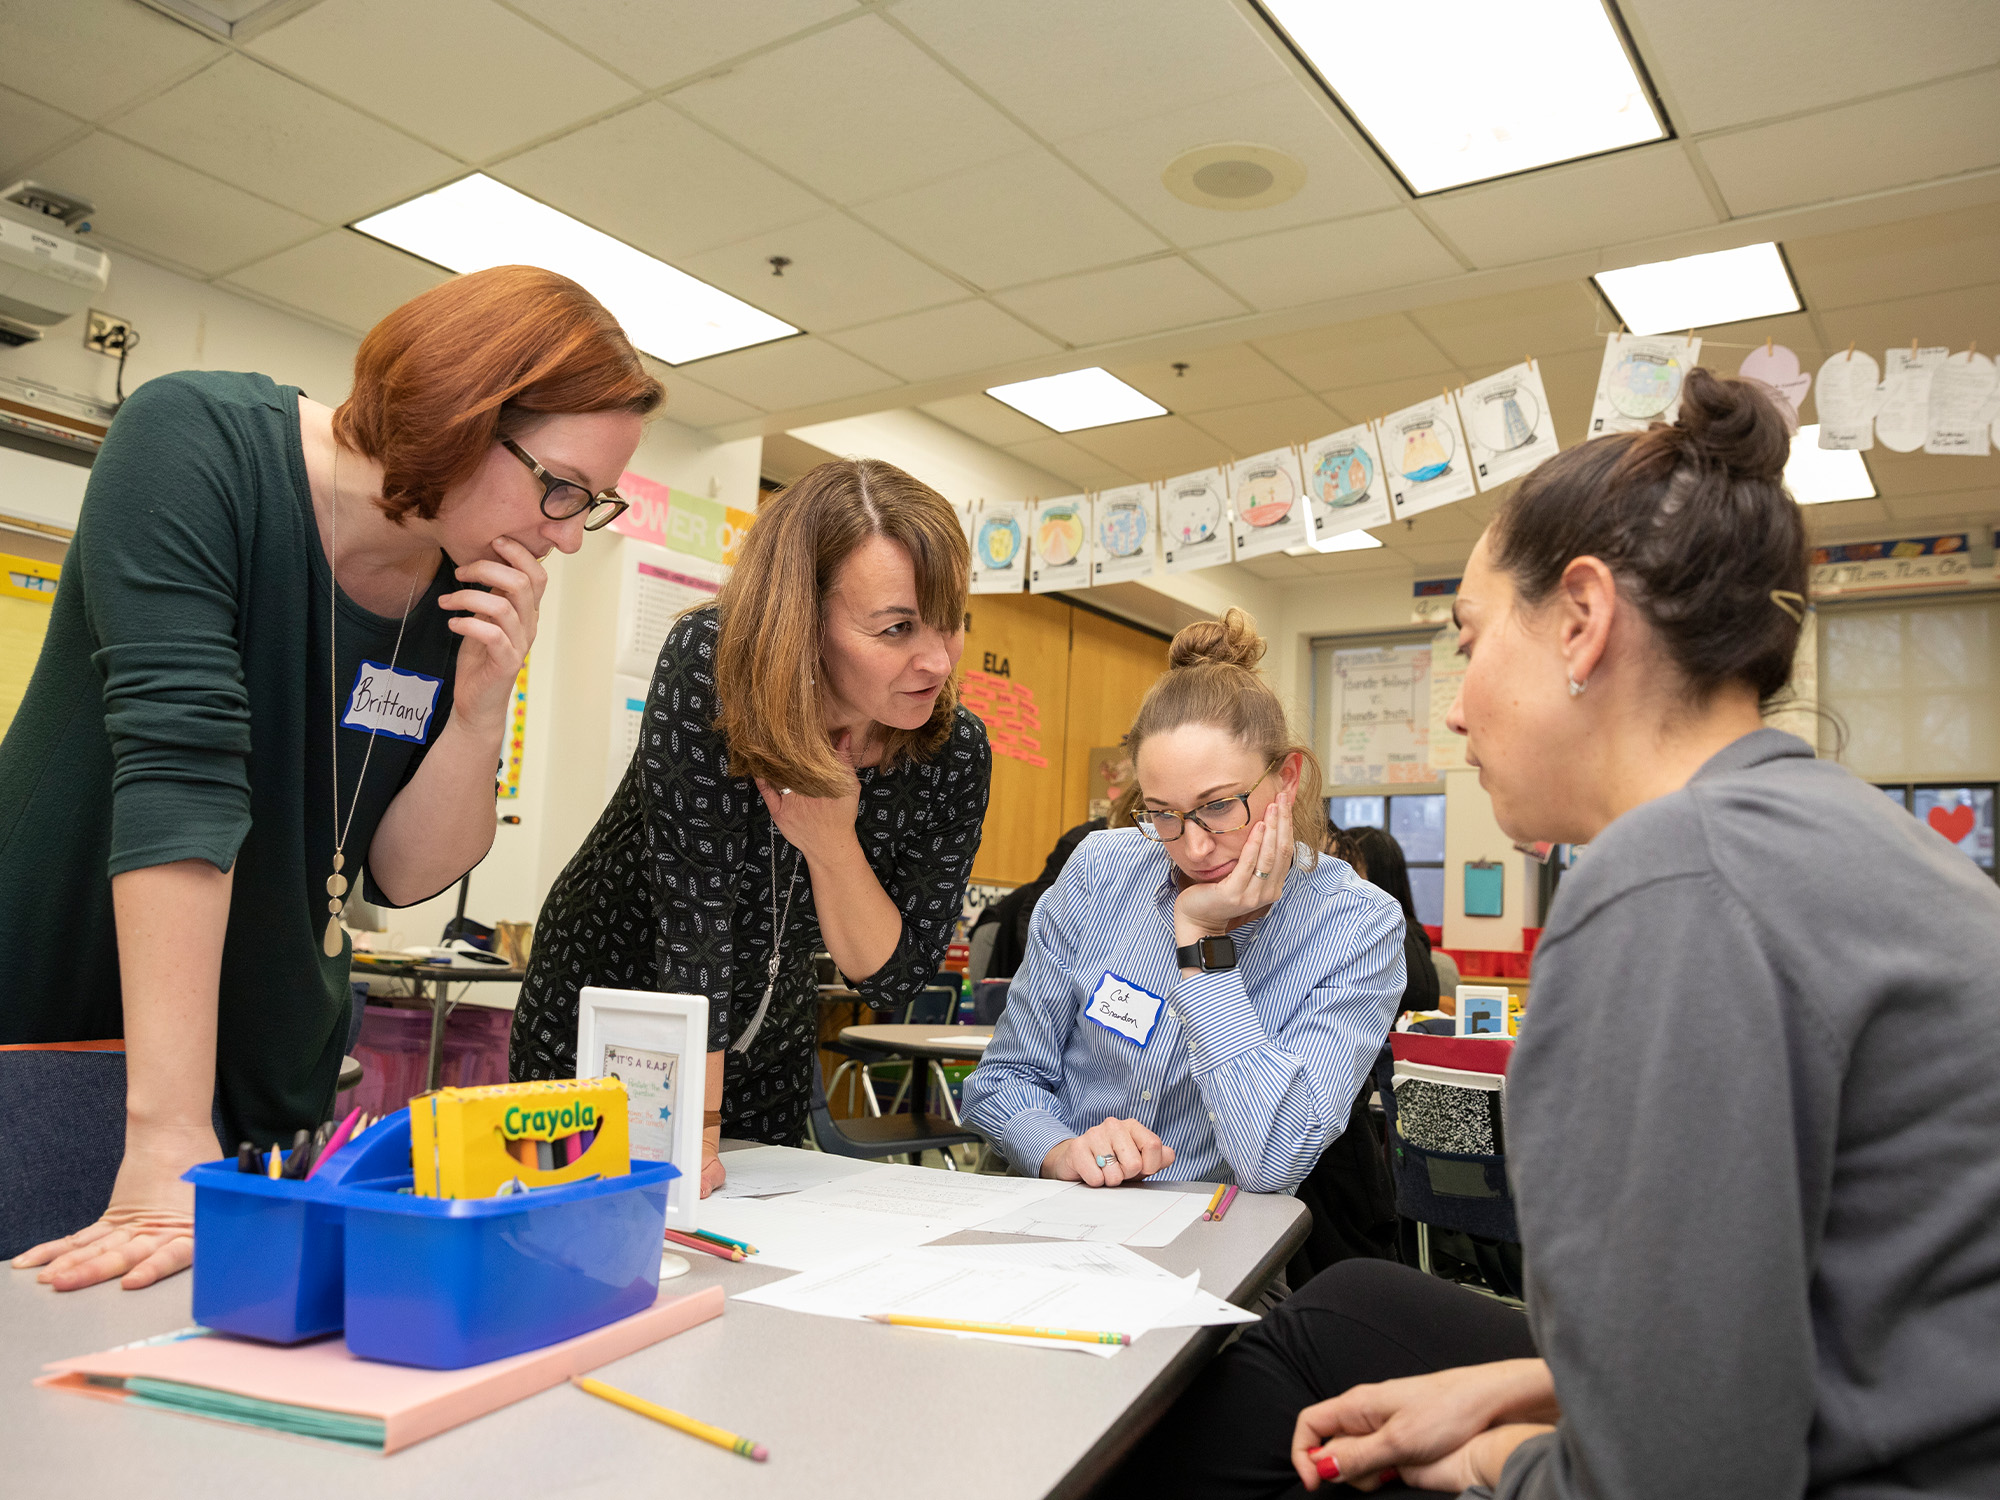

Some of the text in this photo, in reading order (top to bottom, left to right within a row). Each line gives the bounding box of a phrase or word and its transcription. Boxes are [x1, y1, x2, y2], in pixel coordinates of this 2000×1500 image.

[983, 651, 1011, 679] ELA
[353, 676, 428, 738] Brittany
[1109, 989, 1130, 1004] Cat
[1099, 1000, 1138, 1028] Brandon
[635, 1059, 642, 1068] A
[504, 1101, 595, 1137] Crayola
